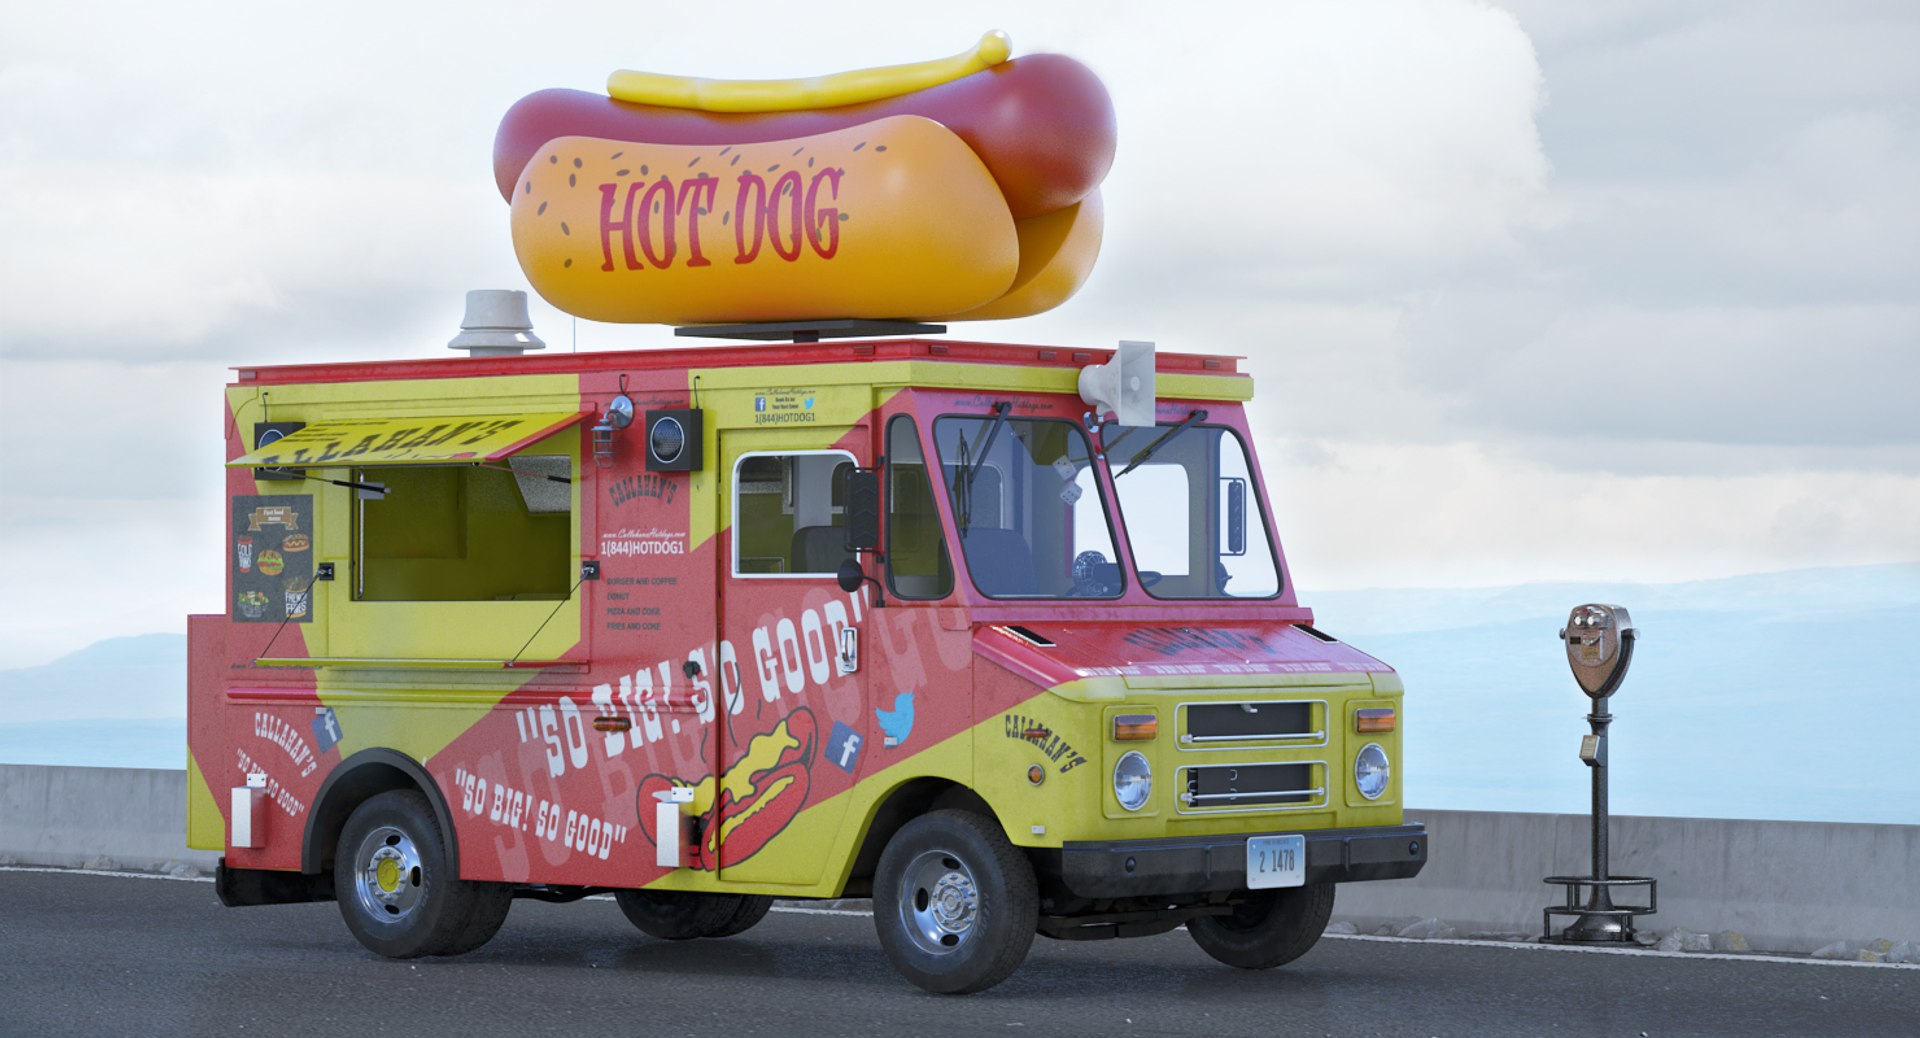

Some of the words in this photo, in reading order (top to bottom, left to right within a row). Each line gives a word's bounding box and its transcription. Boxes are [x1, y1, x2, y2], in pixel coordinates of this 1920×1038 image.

[598, 176, 720, 272] HOT
[733, 166, 842, 265] DOG
[601, 540, 685, 557] 1(844)HOTDOG1
[255, 712, 318, 778] CALLAHAN'S
[490, 783, 533, 832] BIG!
[535, 800, 560, 842] SO
